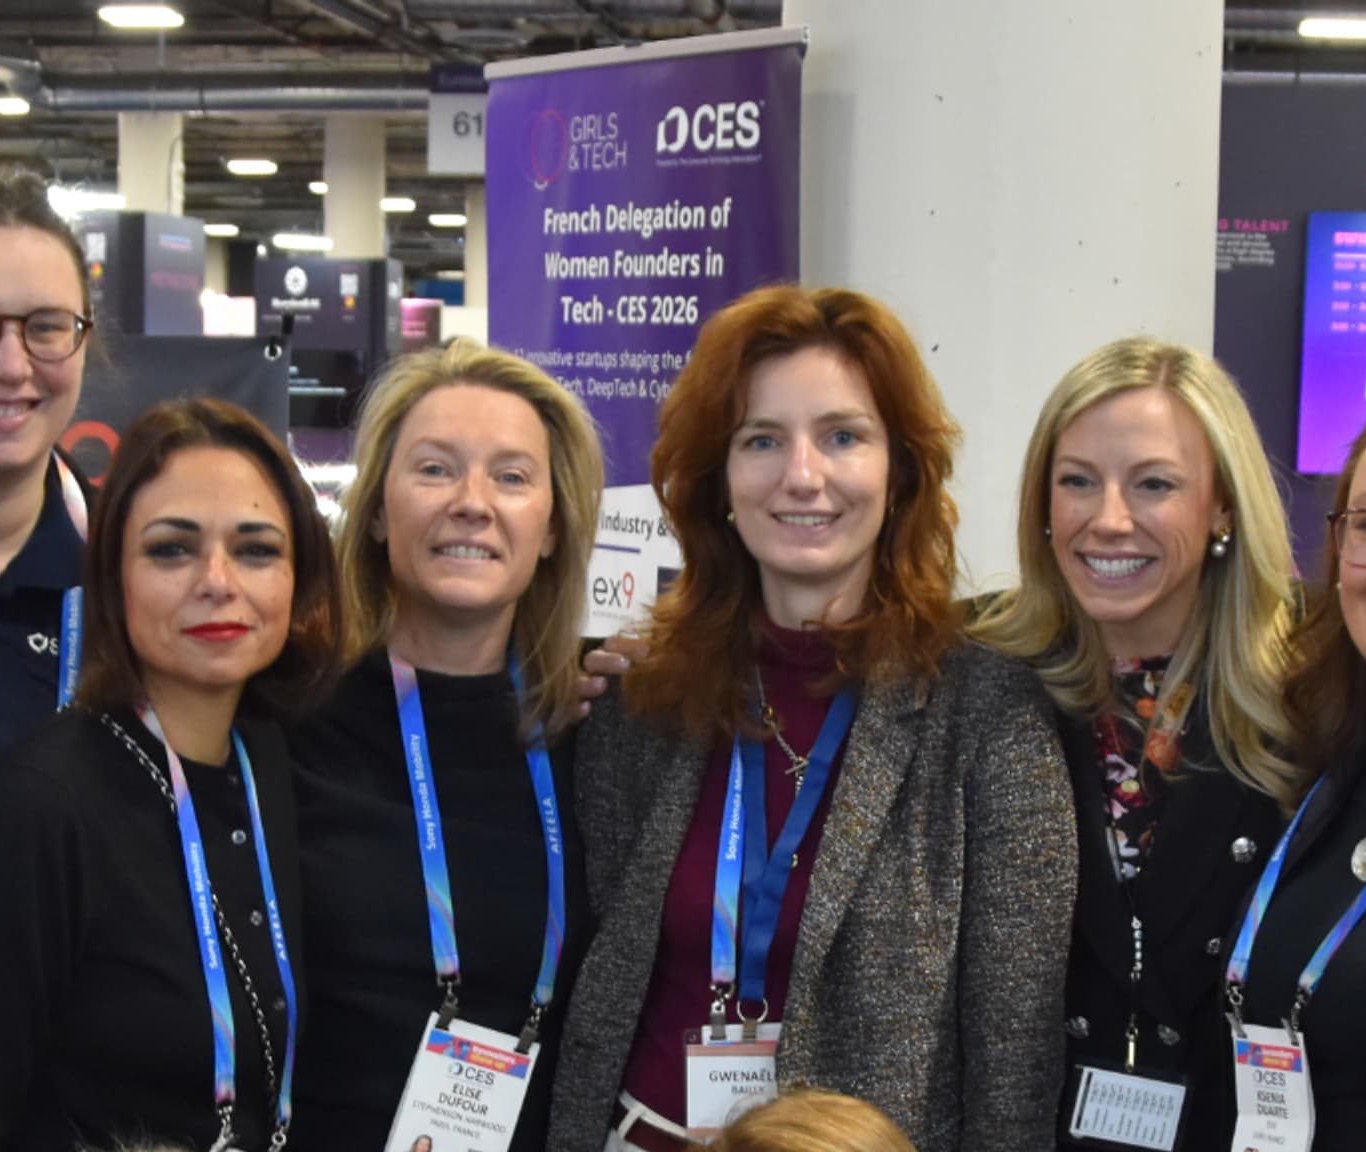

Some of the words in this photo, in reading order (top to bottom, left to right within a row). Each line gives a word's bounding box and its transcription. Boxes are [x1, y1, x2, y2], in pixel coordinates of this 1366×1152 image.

[570, 112, 618, 142] GIRLS
[692, 101, 760, 151] CES
[543, 203, 600, 235] French
[606, 201, 705, 239] Delegation
[710, 196, 733, 229] of
[544, 252, 609, 279] Women
[613, 246, 701, 278] Founders
[705, 246, 724, 276] in
[561, 295, 603, 324] Tech
[616, 296, 646, 324] CES
[650, 296, 699, 325] 2026
[619, 350, 659, 374] shaping
[661, 350, 683, 369] the
[592, 570, 635, 609] ex9
[410, 733, 426, 782] Mobility
[419, 781, 434, 821] Honda
[731, 791, 743, 832] Honda
[426, 821, 438, 852] Sony
[543, 797, 562, 856] AFEELA
[724, 831, 740, 861] Sony
[190, 841, 206, 894] Mobility
[199, 895, 212, 937] Honda
[452, 1082, 483, 1101] ELISE
[464, 1066, 496, 1087] CES
[1264, 1071, 1287, 1088] CES
[438, 1091, 489, 1117] DUFOUR
[1256, 1103, 1289, 1120] DUARTE
